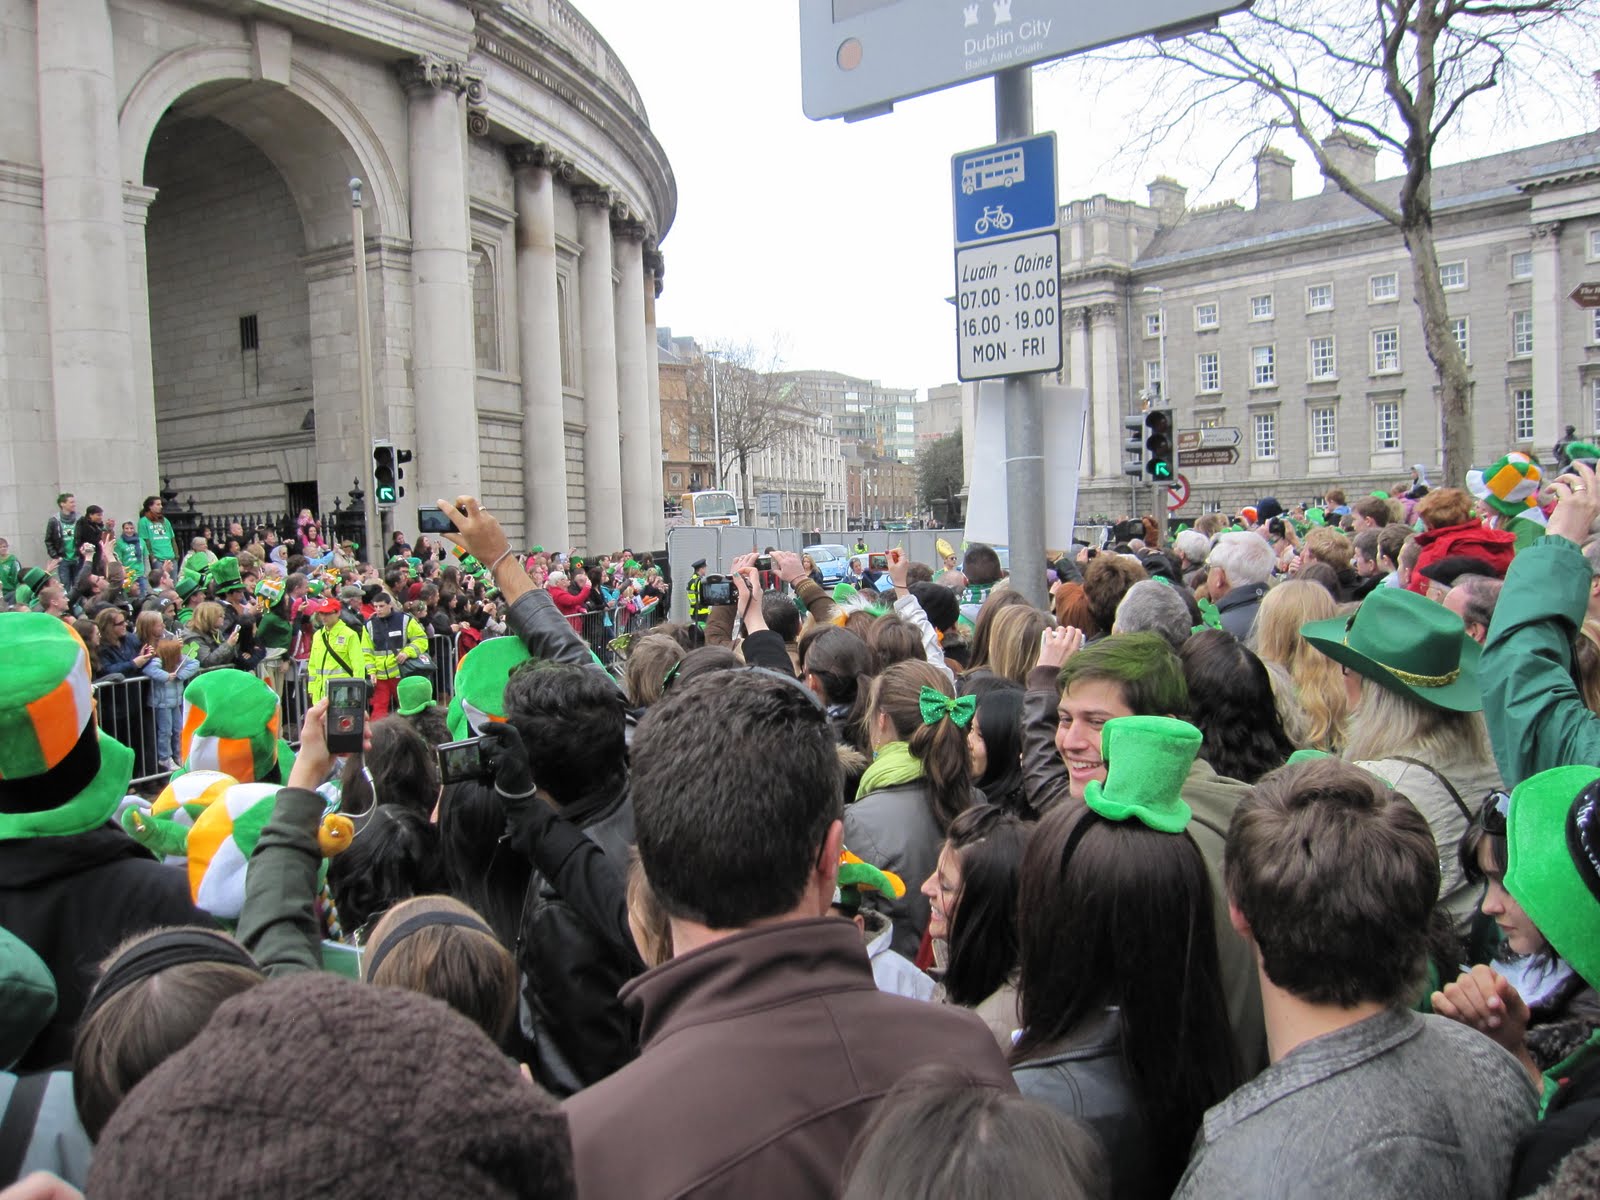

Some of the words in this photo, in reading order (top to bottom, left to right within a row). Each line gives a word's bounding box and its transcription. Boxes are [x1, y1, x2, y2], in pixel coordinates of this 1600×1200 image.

[964, 31, 1014, 56] Dublin
[1019, 19, 1052, 40] City
[962, 261, 998, 283] Luain
[960, 287, 1000, 310] 07.00
[1015, 278, 1056, 302] 10.00
[963, 315, 1000, 337] 16.00
[1015, 307, 1054, 330] 19.00
[973, 341, 1007, 363] MON
[1022, 336, 1045, 357] FRI
